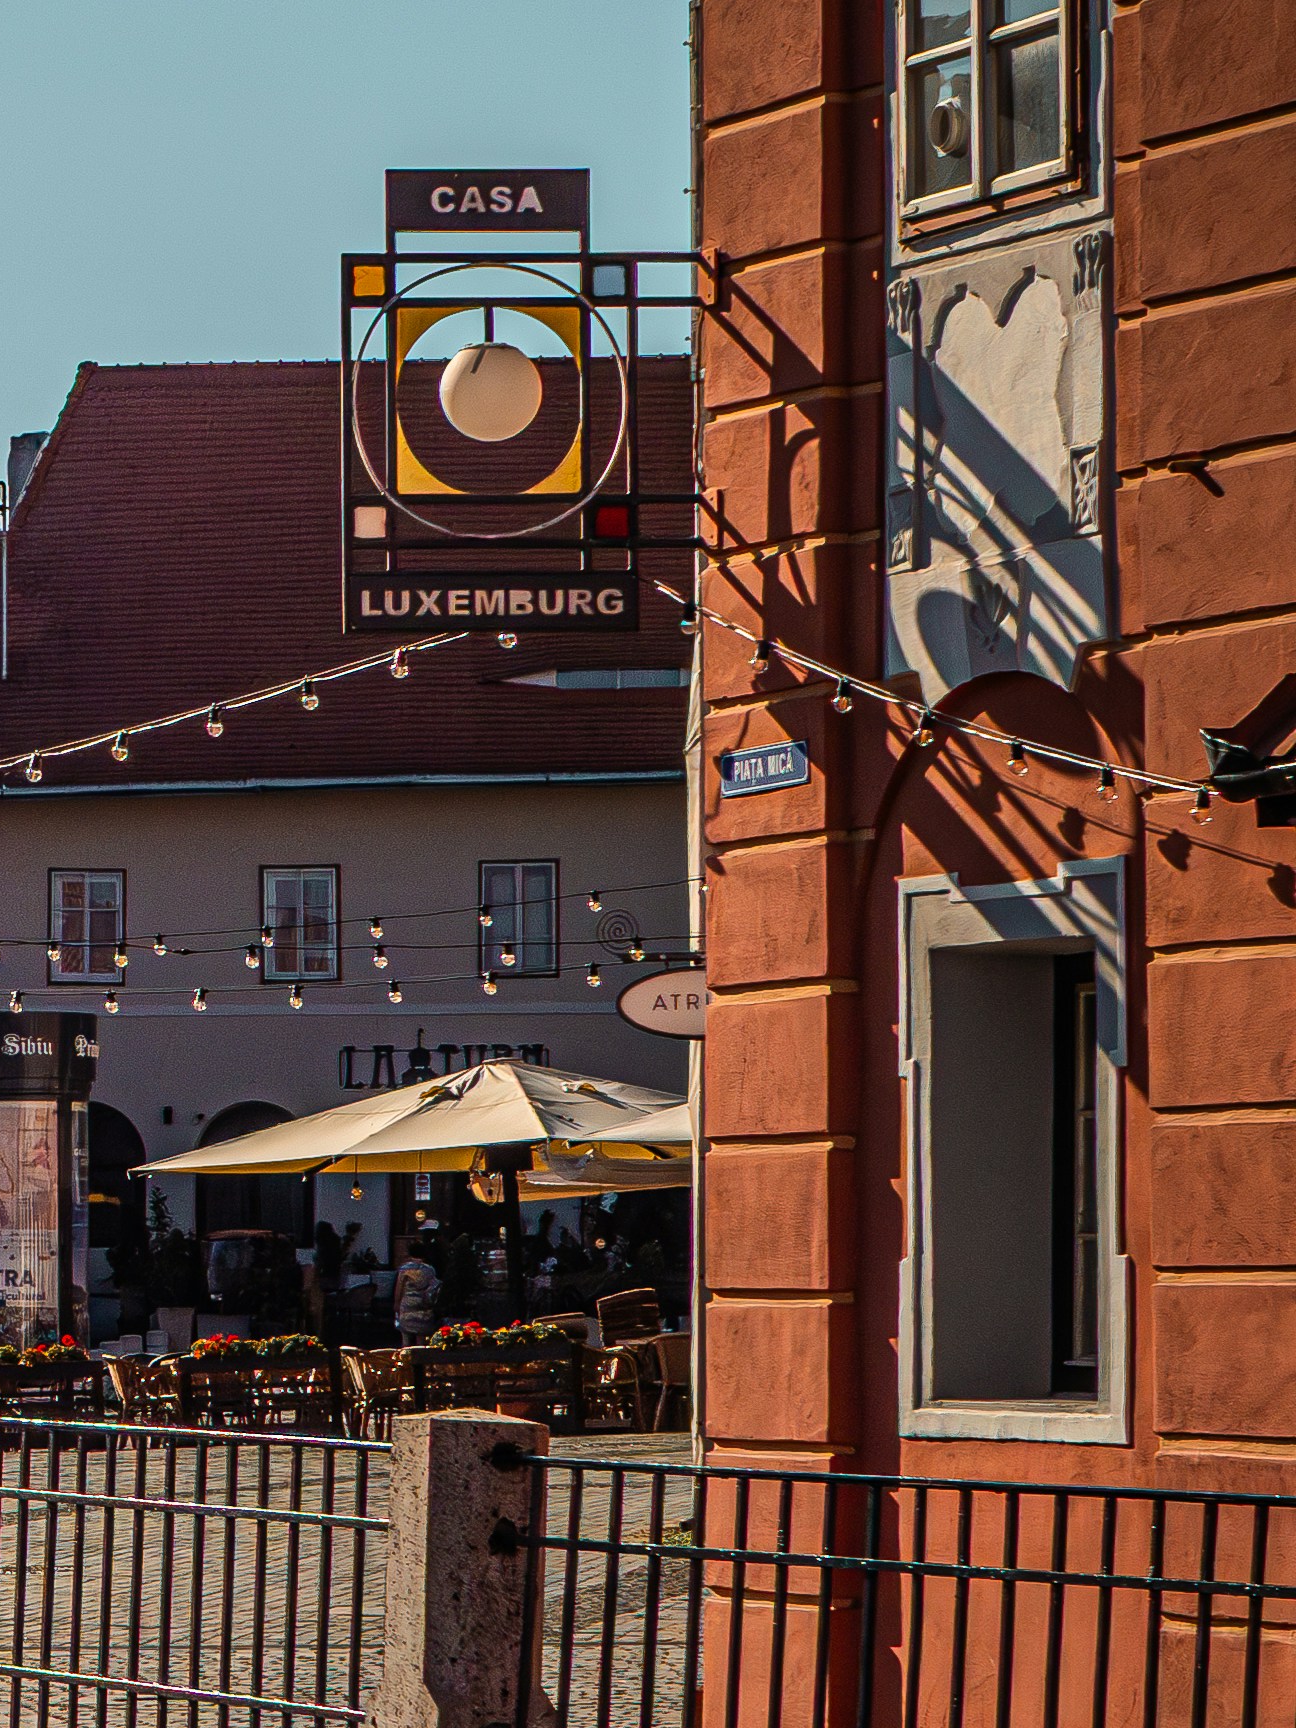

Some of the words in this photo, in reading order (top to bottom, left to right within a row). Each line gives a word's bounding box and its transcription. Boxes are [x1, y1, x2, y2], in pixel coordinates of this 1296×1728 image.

[430, 186, 544, 214] CASA
[361, 588, 625, 617] LUXEMBURG
[1, 1033, 53, 1056] Sibiu
